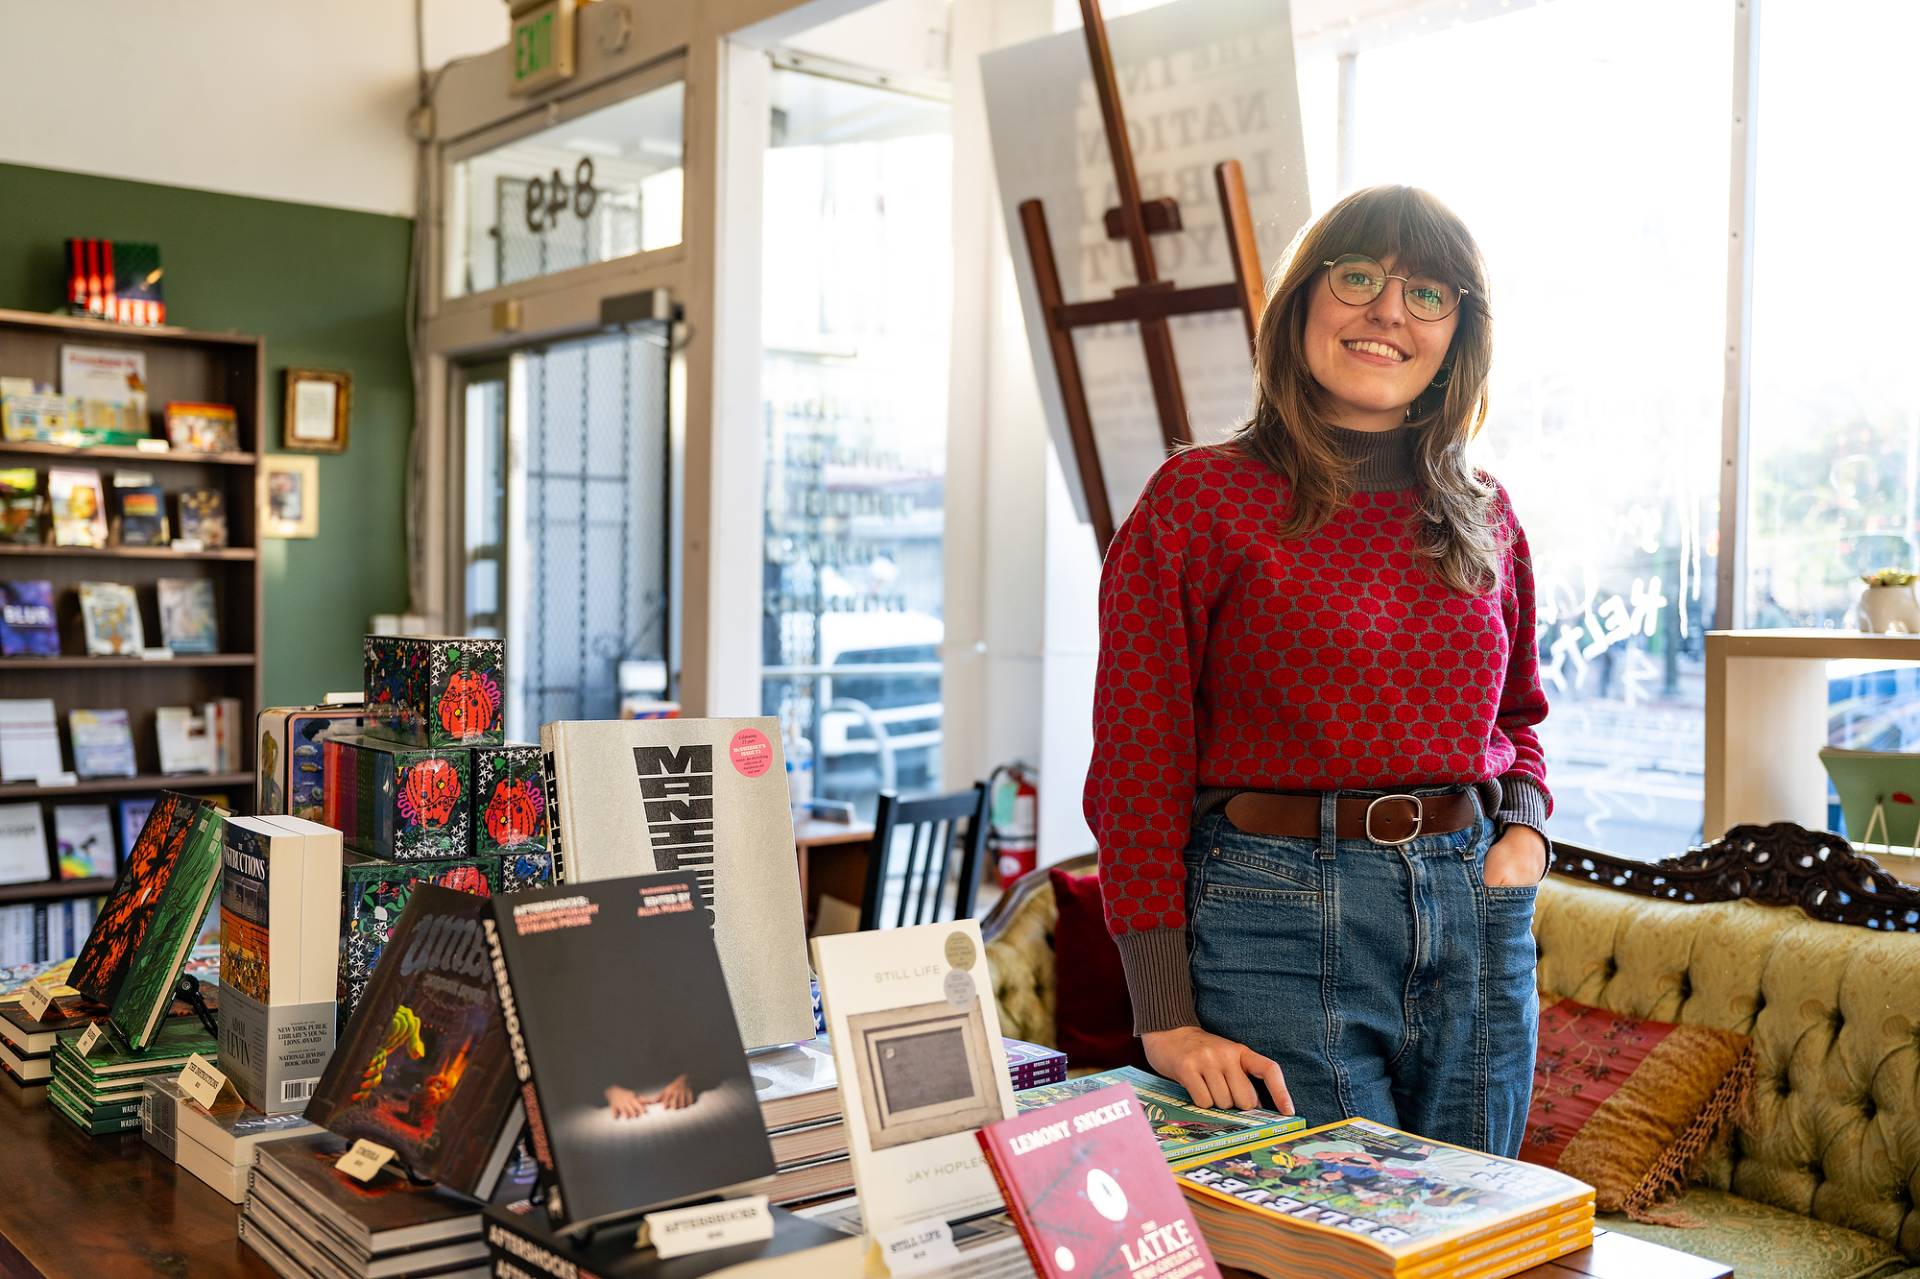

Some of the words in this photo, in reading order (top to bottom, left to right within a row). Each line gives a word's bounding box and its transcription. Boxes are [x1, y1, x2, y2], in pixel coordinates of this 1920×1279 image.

[874, 969, 910, 984] STILL
[914, 964, 941, 978] LIFE
[1009, 1119, 1072, 1156] LEMONY
[1072, 1099, 1132, 1134] SNICKET
[1184, 1167, 1411, 1244] BELIEVER
[1120, 1218, 1194, 1272] LATKE
